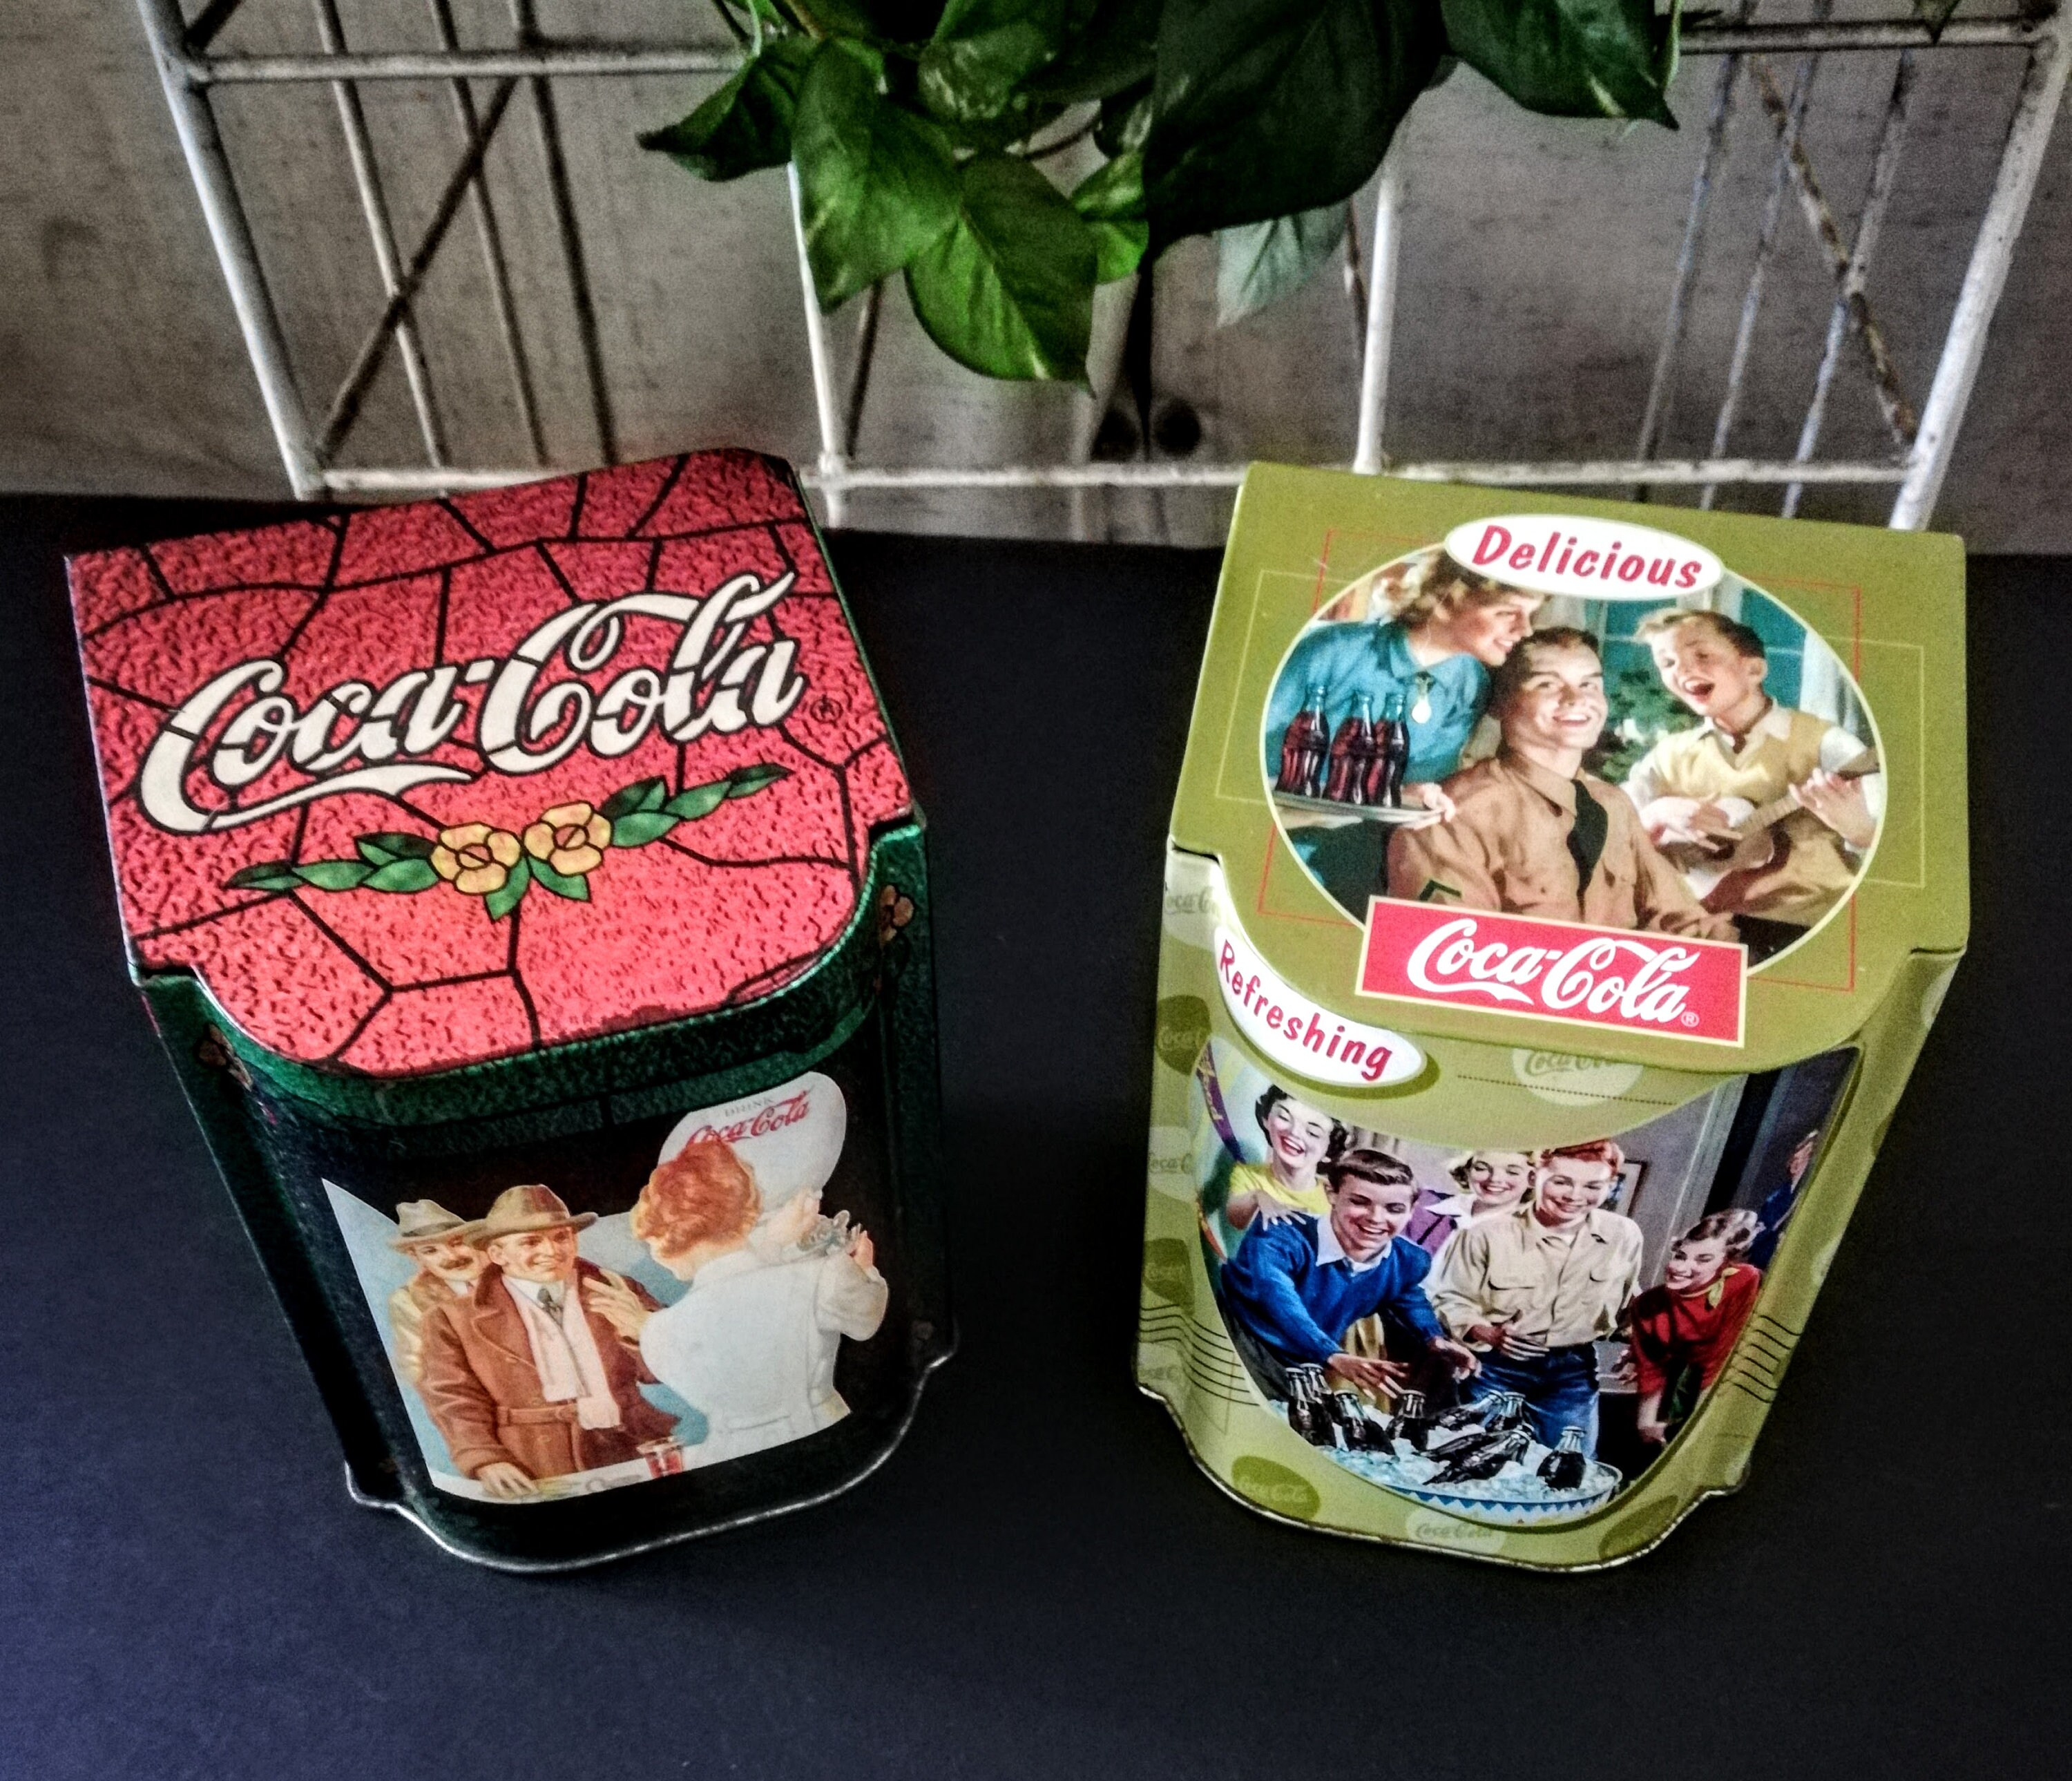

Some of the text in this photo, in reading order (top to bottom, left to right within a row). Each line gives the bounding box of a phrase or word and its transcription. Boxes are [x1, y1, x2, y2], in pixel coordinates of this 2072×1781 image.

[1471, 524, 1702, 589] Delicious
[137, 570, 807, 833] Coca-Cola
[1219, 938, 1393, 1082] Refreshing
[1406, 917, 1701, 1024] Coca-Cola
